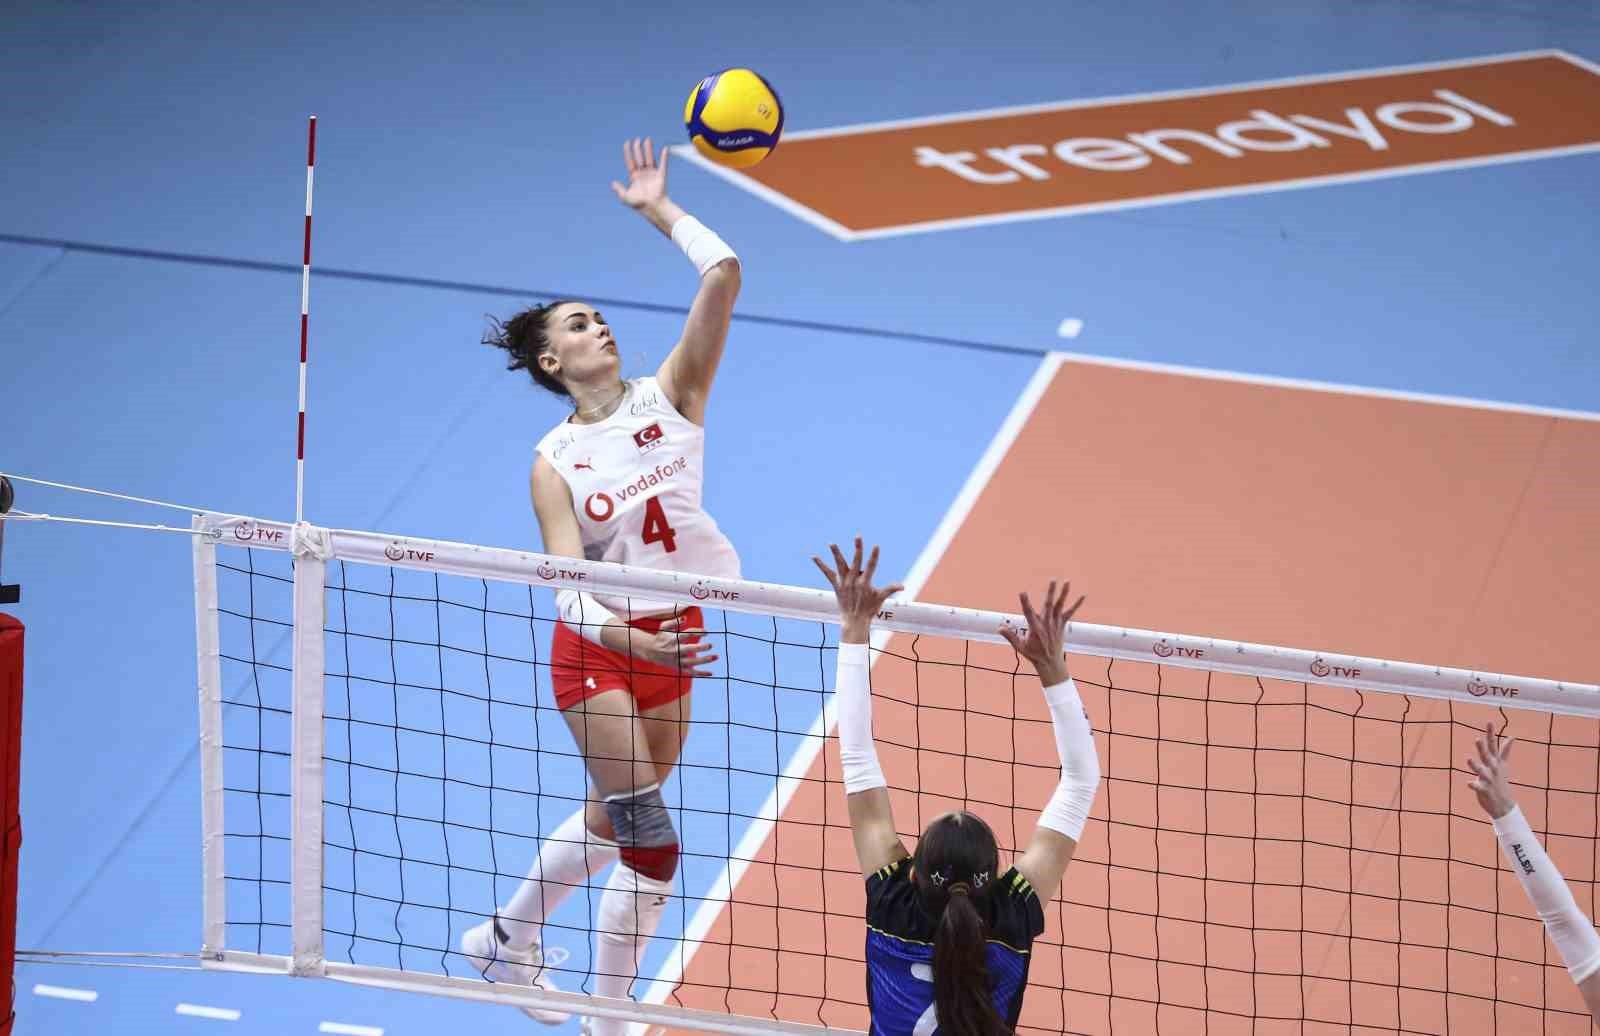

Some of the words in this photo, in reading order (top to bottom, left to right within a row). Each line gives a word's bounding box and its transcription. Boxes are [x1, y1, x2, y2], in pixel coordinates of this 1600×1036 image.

[914, 89, 1516, 184] trendyol
[616, 457, 688, 501] vodafone
[641, 495, 676, 553] 4
[256, 528, 284, 542] TVF
[407, 549, 435, 562] TVF
[558, 569, 587, 582] TVF
[711, 589, 741, 601] TVF
[877, 610, 894, 621] VF
[1175, 646, 1204, 659] TVF
[1331, 666, 1361, 679] TVF
[1490, 686, 1520, 698] TVF
[1511, 842, 1537, 876] ALLSIX
